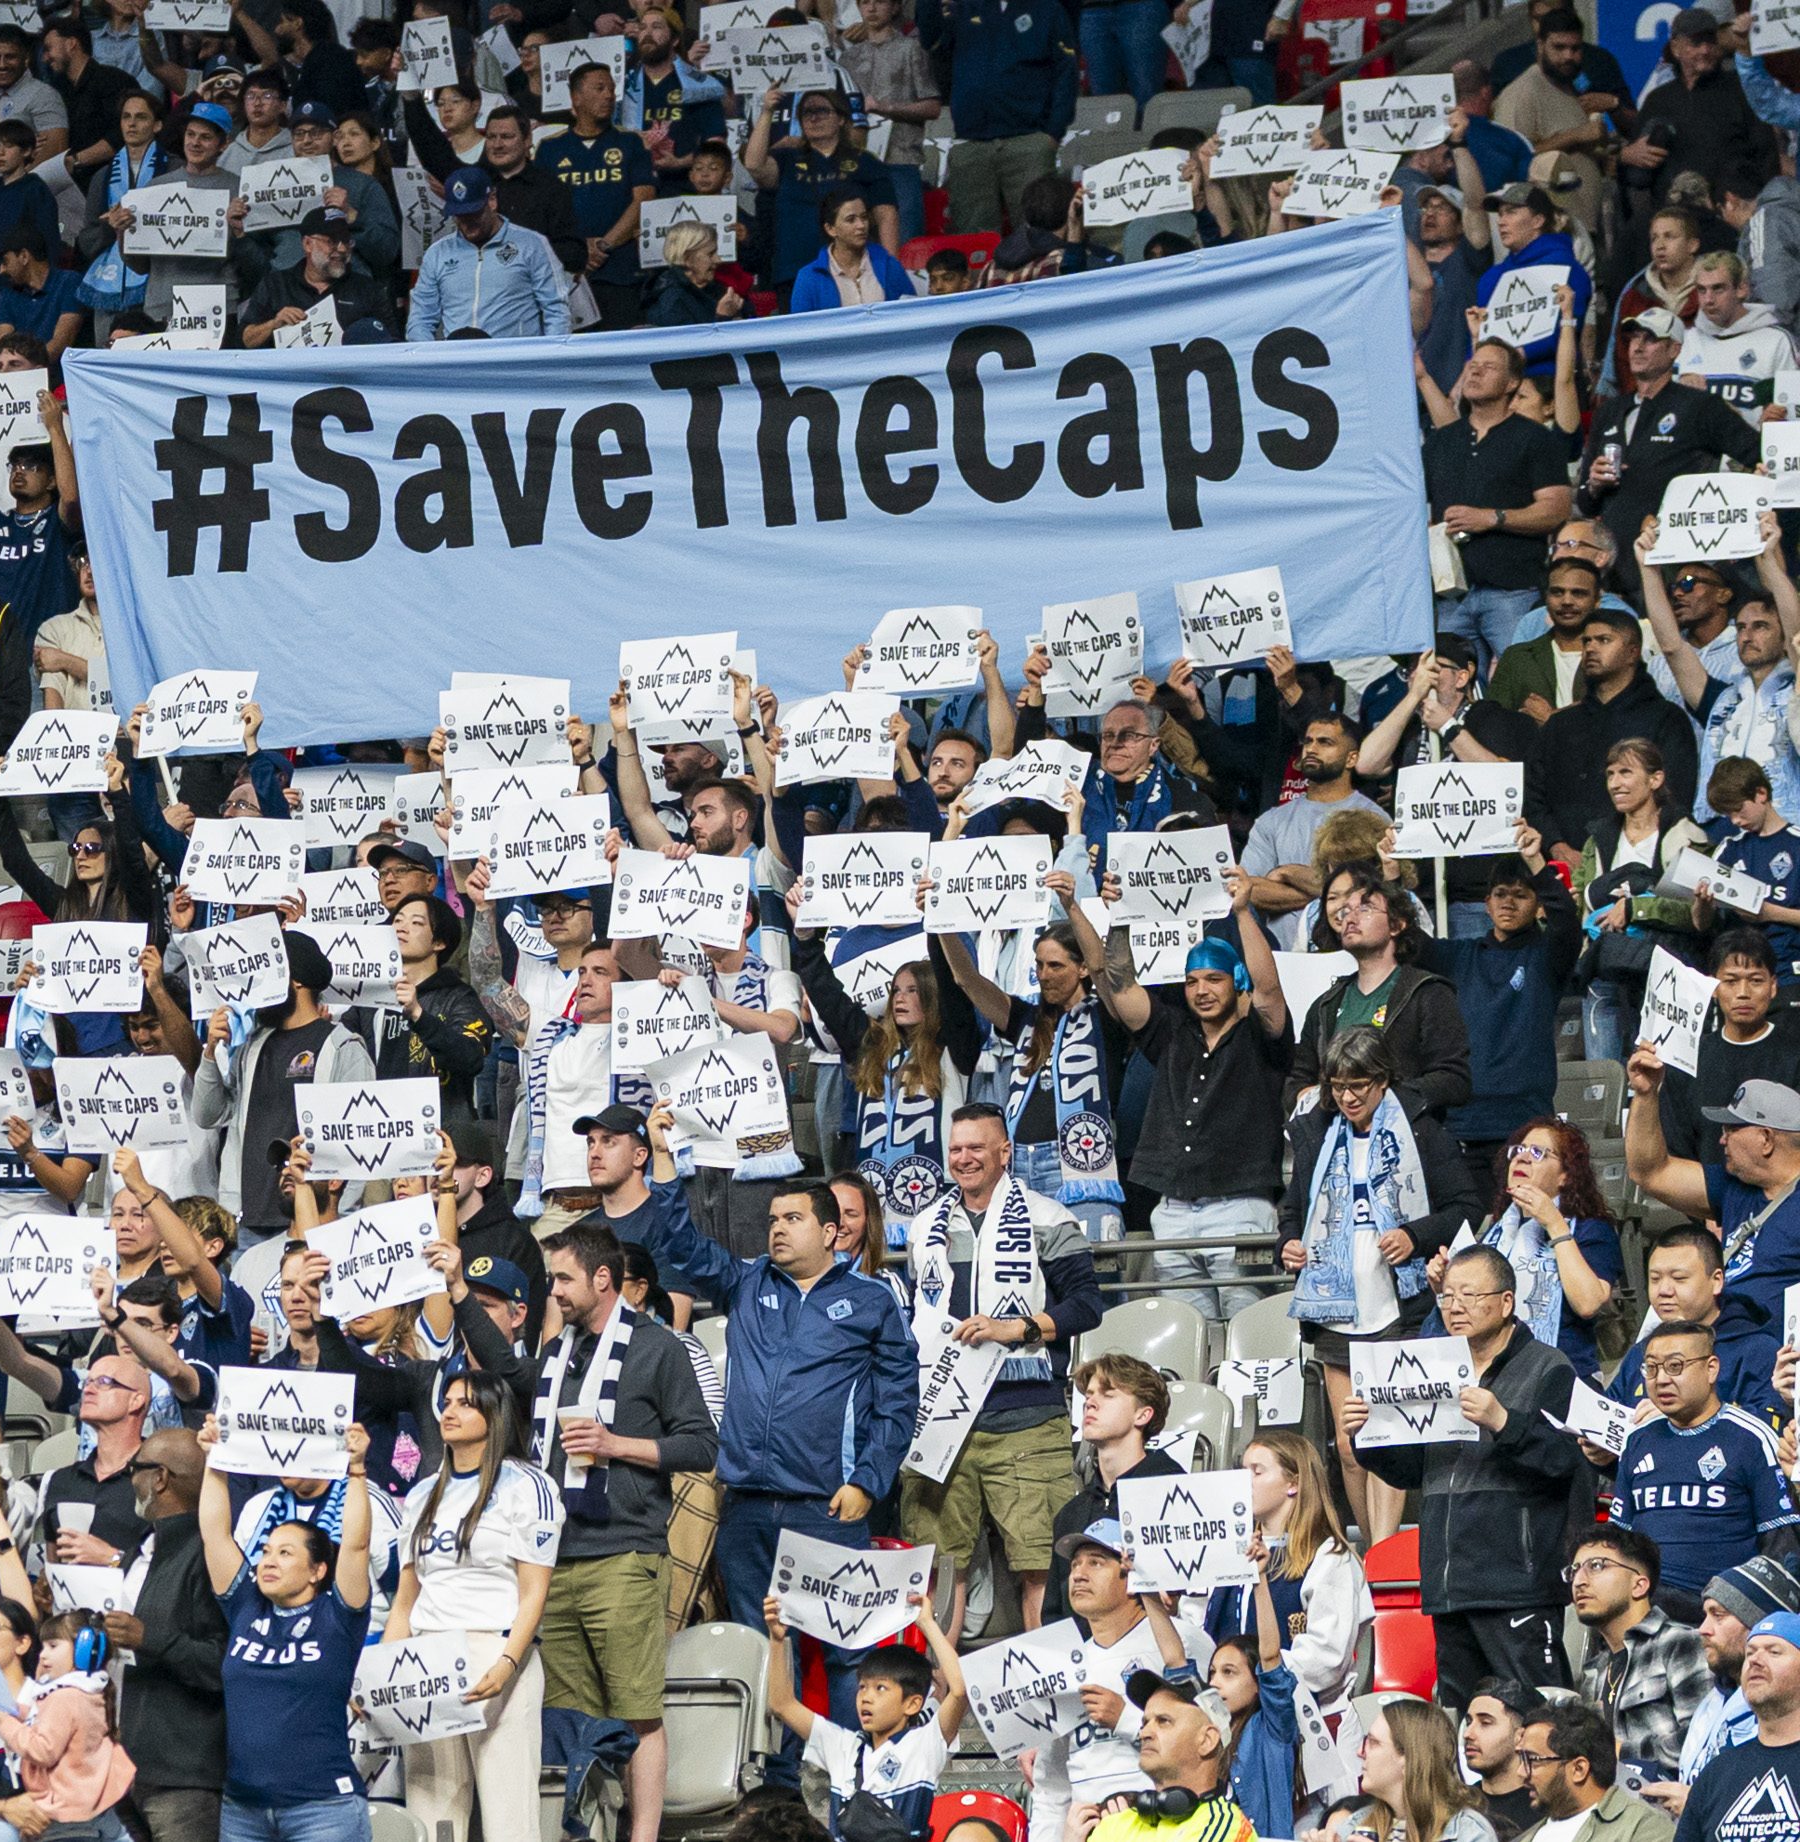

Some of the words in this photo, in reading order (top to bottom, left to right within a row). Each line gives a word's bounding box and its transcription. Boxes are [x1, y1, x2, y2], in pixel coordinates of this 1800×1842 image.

[645, 107, 683, 121] LUS
[1362, 108, 1390, 124] SAVE
[1391, 108, 1407, 119] THE
[1407, 104, 1437, 120] CAPS
[558, 168, 623, 185] TELUS
[142, 213, 167, 227] SAVE
[168, 216, 182, 226] THE
[183, 215, 210, 228] CAPS
[152, 325, 1340, 578] #SaveTheCaps
[1669, 511, 1697, 528] SAVE
[1699, 511, 1715, 524] THE
[1717, 508, 1748, 525] CAPS
[880, 645, 909, 662] SAVE
[911, 646, 927, 658] THE
[929, 642, 960, 659] CAPS
[464, 723, 495, 741] SAVE
[495, 723, 513, 736] THE
[514, 718, 548, 736] CAPS
[16, 747, 43, 763] SAVE
[45, 747, 60, 759] THE
[61, 744, 90, 760] CAPS
[1411, 802, 1441, 820] SAVE
[1442, 803, 1460, 816] THE
[1462, 799, 1496, 817] CAPS
[505, 840, 534, 859] SAVE
[535, 839, 553, 853] THE
[554, 833, 587, 853] CAPS
[821, 872, 852, 890] SAVE
[854, 873, 871, 886] THE
[873, 871, 904, 888] CAPS
[638, 888, 669, 904] SAVE
[671, 887, 687, 900] THE
[688, 889, 724, 910] CAPS
[677, 1086, 703, 1108] SAVE
[705, 1084, 722, 1099] THE
[724, 1076, 758, 1098] CAPS
[78, 1098, 107, 1115] SAVE
[107, 1100, 123, 1113] THE
[124, 1096, 159, 1115] CAPS
[321, 1123, 354, 1141] SAVE
[356, 1124, 375, 1138] THE
[377, 1120, 414, 1139] CAPS
[1059, 1112, 1112, 1138] VANCOUVER
[887, 1155, 942, 1180] VANCOUVER
[1060, 1144, 1087, 1170] SOUTH
[337, 1257, 360, 1281] SAVE
[361, 1253, 375, 1267] THE
[378, 1241, 414, 1265] CAPS
[994, 1260, 1032, 1284] FC
[931, 1346, 961, 1385] CAPS
[923, 1382, 941, 1405] THE
[1370, 1385, 1401, 1404] SAVE
[1400, 1387, 1419, 1400] THE
[1418, 1381, 1453, 1400] CAPS
[237, 1412, 271, 1432] SAVE
[271, 1417, 291, 1432] THE
[291, 1416, 327, 1436] CAPS
[1631, 1485, 1727, 1511] TELUS
[1140, 1524, 1173, 1545] SAVE
[1173, 1525, 1191, 1540] THE
[1193, 1519, 1227, 1542] CAPS
[801, 1575, 840, 1602] SAVE
[841, 1591, 861, 1608] THE
[862, 1589, 899, 1608] CAPS
[230, 1636, 322, 1665] TELUS
[370, 1685, 400, 1708] SAVE
[400, 1684, 417, 1700] THE
[419, 1675, 450, 1698] CAPS
[990, 1689, 1019, 1714] SAVE
[1016, 1685, 1034, 1703] THE
[1033, 1671, 1068, 1699] CAPS
[1737, 1811, 1787, 1825] VANCOUVER
[1719, 1821, 1800, 1839] WHITECAPS
